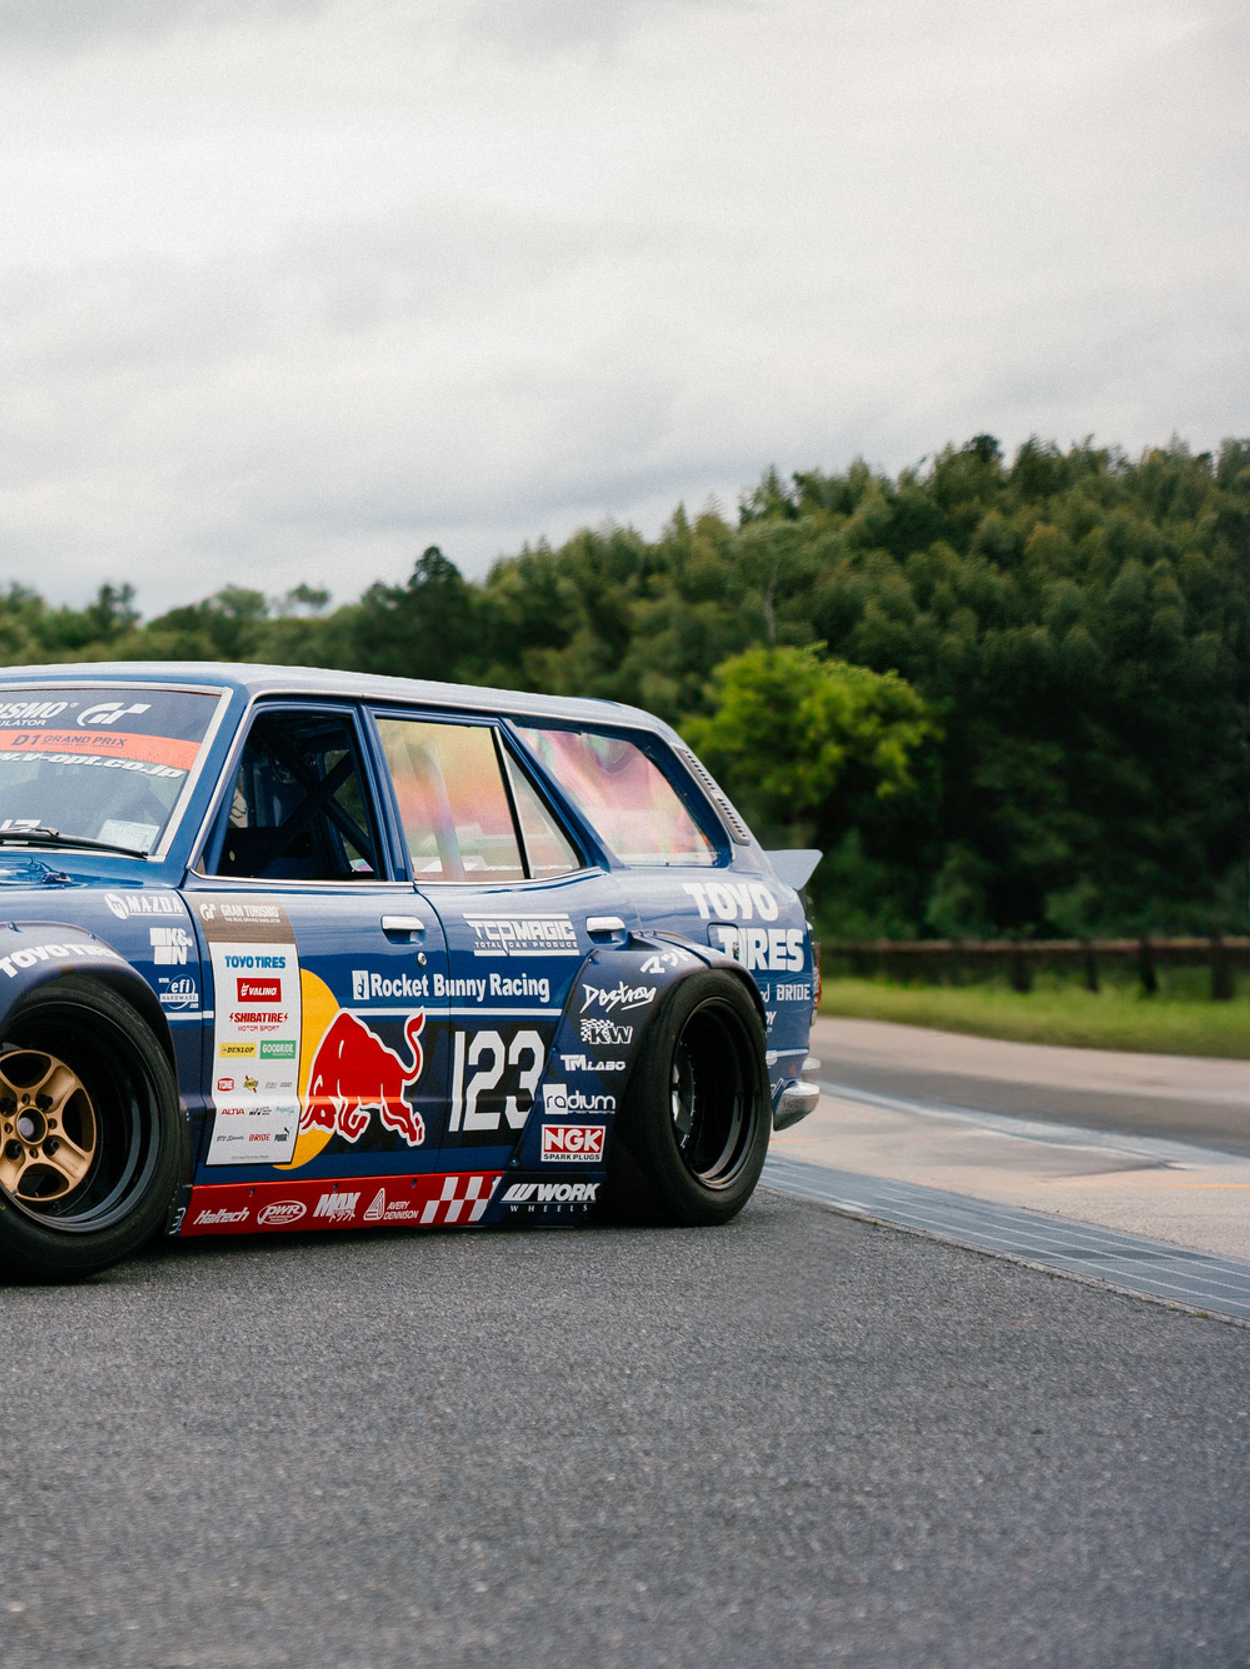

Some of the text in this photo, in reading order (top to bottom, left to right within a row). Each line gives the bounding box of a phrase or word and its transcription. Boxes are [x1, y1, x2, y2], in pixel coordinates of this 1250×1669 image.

[11, 734, 129, 746] D1 GRAND PRIX
[125, 895, 184, 913] MAZDA
[681, 882, 779, 922] TOYO
[717, 927, 805, 973] TIRES
[224, 955, 286, 969] TOYO TIRES
[170, 979, 191, 994] efi
[370, 973, 550, 1003] Rocket Bunny Racing
[776, 984, 811, 1001] BRIDE
[233, 1012, 284, 1023] SHIBATIRE
[589, 1025, 634, 1045] KW
[449, 1030, 546, 1133] 123
[544, 1128, 603, 1152] NGK
[543, 1153, 601, 1161] SPARK PLUGS
[537, 1183, 602, 1202] WORK
[386, 1200, 411, 1211] AVERY
[510, 1204, 588, 1213] WHEELS
[192, 1207, 250, 1226] Haltech
[383, 1209, 419, 1221] DENNISON
